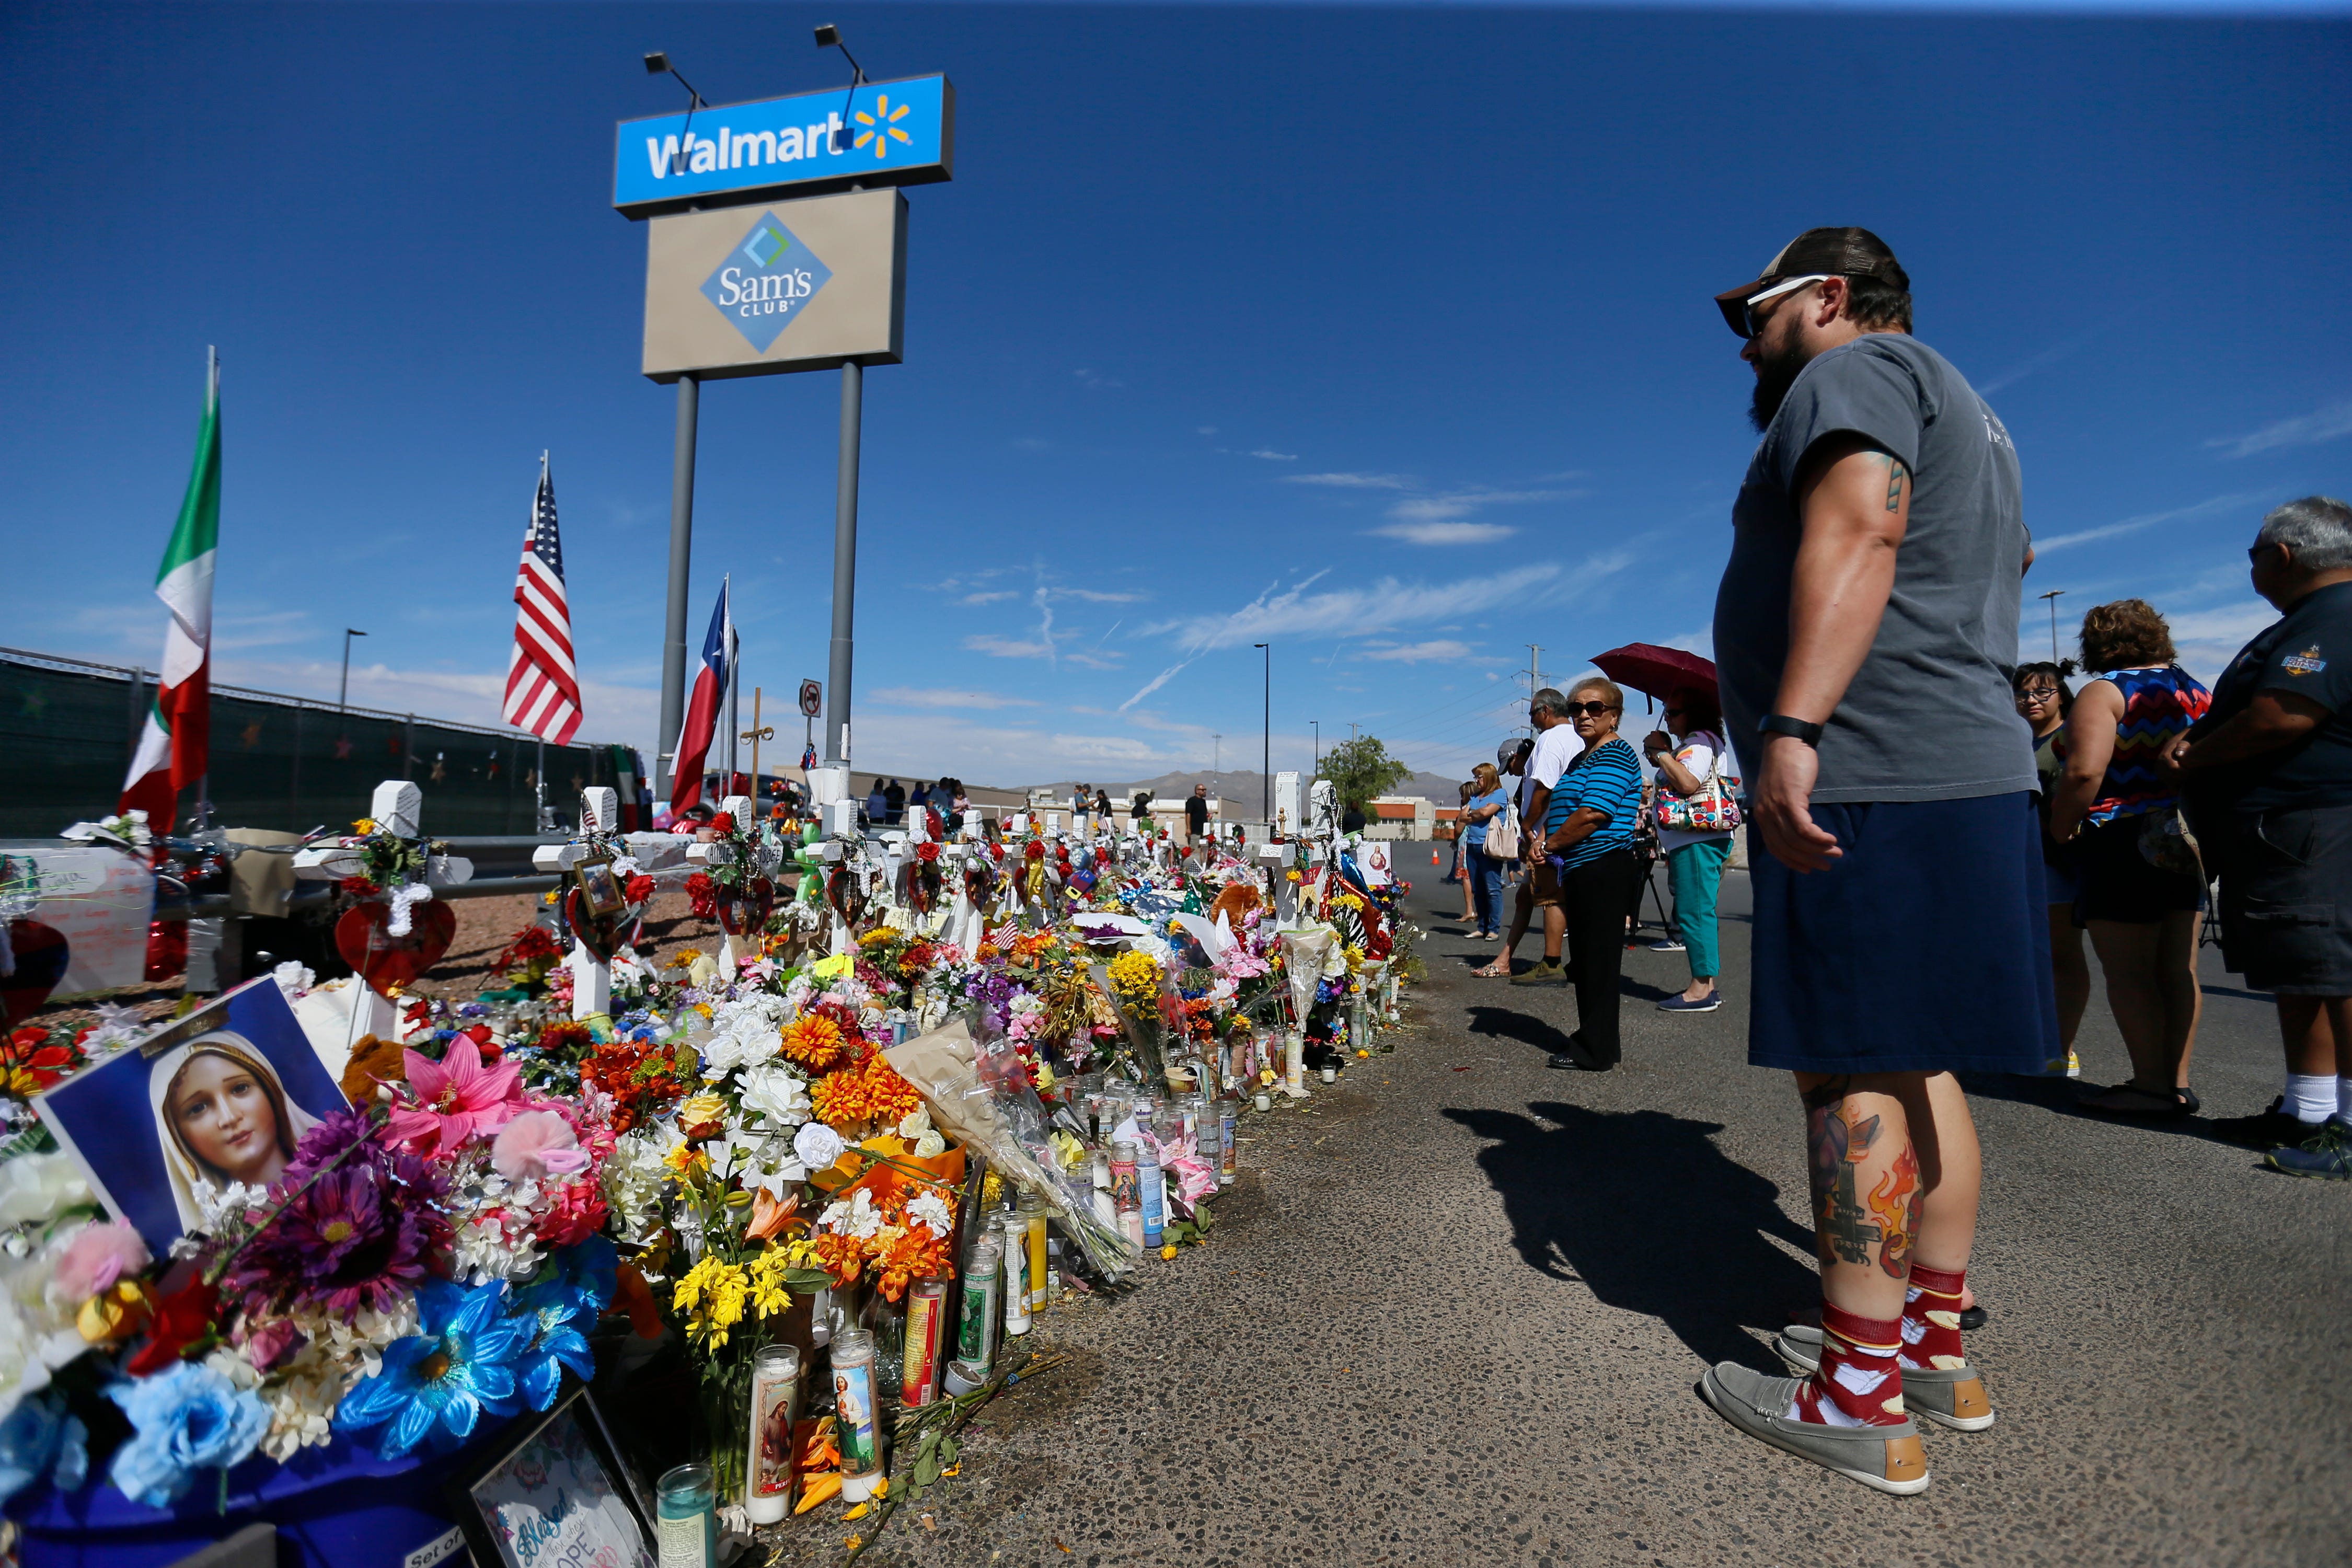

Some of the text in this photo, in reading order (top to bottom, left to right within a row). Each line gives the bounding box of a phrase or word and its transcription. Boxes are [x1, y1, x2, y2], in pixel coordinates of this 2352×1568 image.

[647, 112, 843, 179] Walmart
[719, 267, 812, 306] Sam's
[740, 300, 788, 317] CLUB
[759, 849, 782, 863] ISBEE
[1300, 887, 1316, 902] LOVE
[517, 1486, 578, 1567] Blessed
[548, 1541, 566, 1558] those
[566, 1517, 586, 1539] whose
[411, 1529, 461, 1568] Set of
[557, 1531, 596, 1568] OPE
